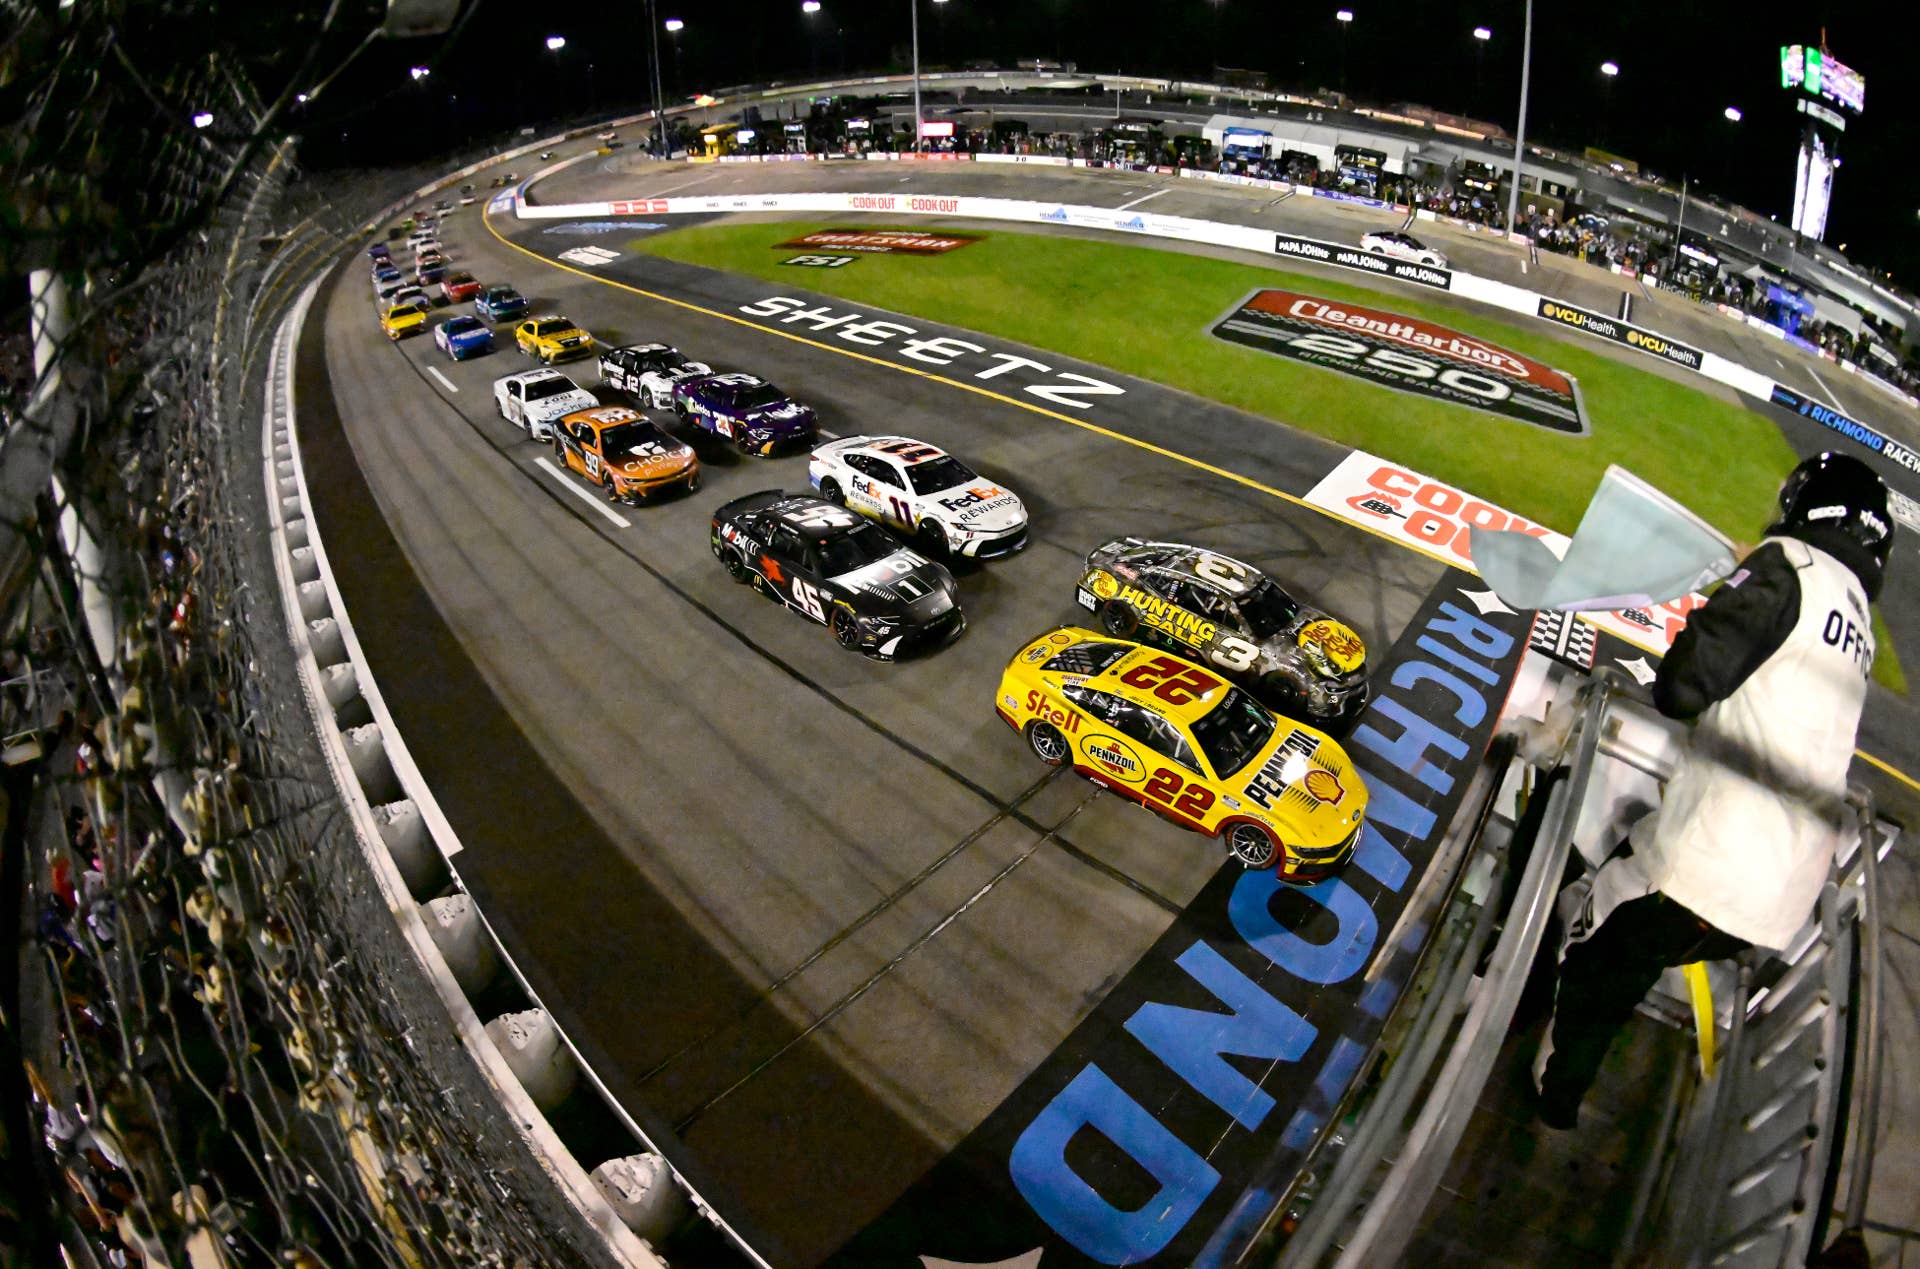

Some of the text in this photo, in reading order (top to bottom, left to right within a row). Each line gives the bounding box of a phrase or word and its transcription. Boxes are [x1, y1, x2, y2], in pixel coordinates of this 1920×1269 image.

[853, 197, 896, 209] COOK OUT
[912, 199, 958, 212] COOK OUT
[803, 235, 957, 247] CRAFTSMAN
[1278, 241, 1300, 253] PAPA
[786, 255, 854, 267] FS1
[1337, 253, 1358, 264] PAPA
[1396, 266, 1417, 277] PAPA
[1555, 306, 1584, 325] VCU
[739, 296, 1126, 409] SHEETZ
[1638, 334, 1667, 353] VCU
[1287, 334, 1512, 401] 250
[1299, 351, 1494, 406] RICHMOND RACEWAY
[1810, 405, 1884, 451] RICHMOND
[585, 450, 599, 478] 99
[852, 474, 881, 500] FedEx
[937, 487, 1004, 512] FedEx
[889, 495, 915, 528] 11
[959, 496, 1018, 523] REWARDS
[721, 522, 749, 551] Mobil
[1194, 553, 1247, 594] 3
[791, 576, 826, 622] 45
[898, 580, 922, 596] 1
[1118, 585, 1217, 642] HUNTING
[1144, 612, 1204, 649] SALE
[1211, 636, 1261, 672] 3
[1120, 656, 1224, 705] 22
[1025, 689, 1082, 733] Shell
[1089, 744, 1137, 772] PENNZOIL
[1143, 767, 1216, 820] 22
